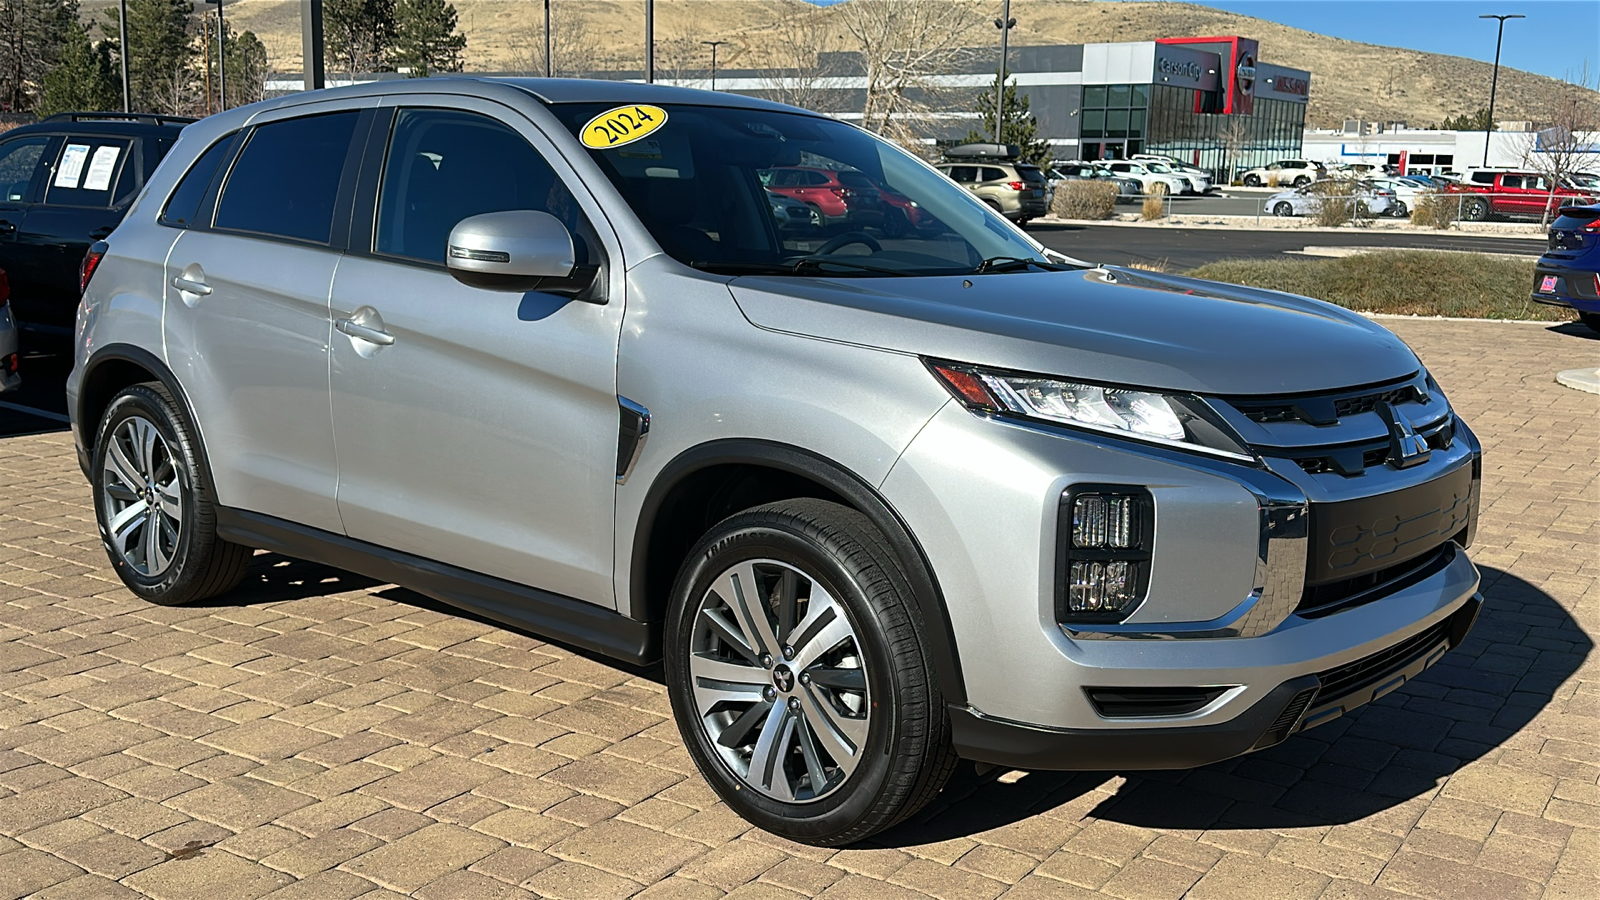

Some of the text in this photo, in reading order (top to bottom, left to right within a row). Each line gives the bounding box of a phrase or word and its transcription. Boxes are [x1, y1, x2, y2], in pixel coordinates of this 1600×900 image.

[1159, 57, 1202, 82] Carson City
[594, 106, 653, 144] 2024
[704, 532, 787, 561] TRAVELST
